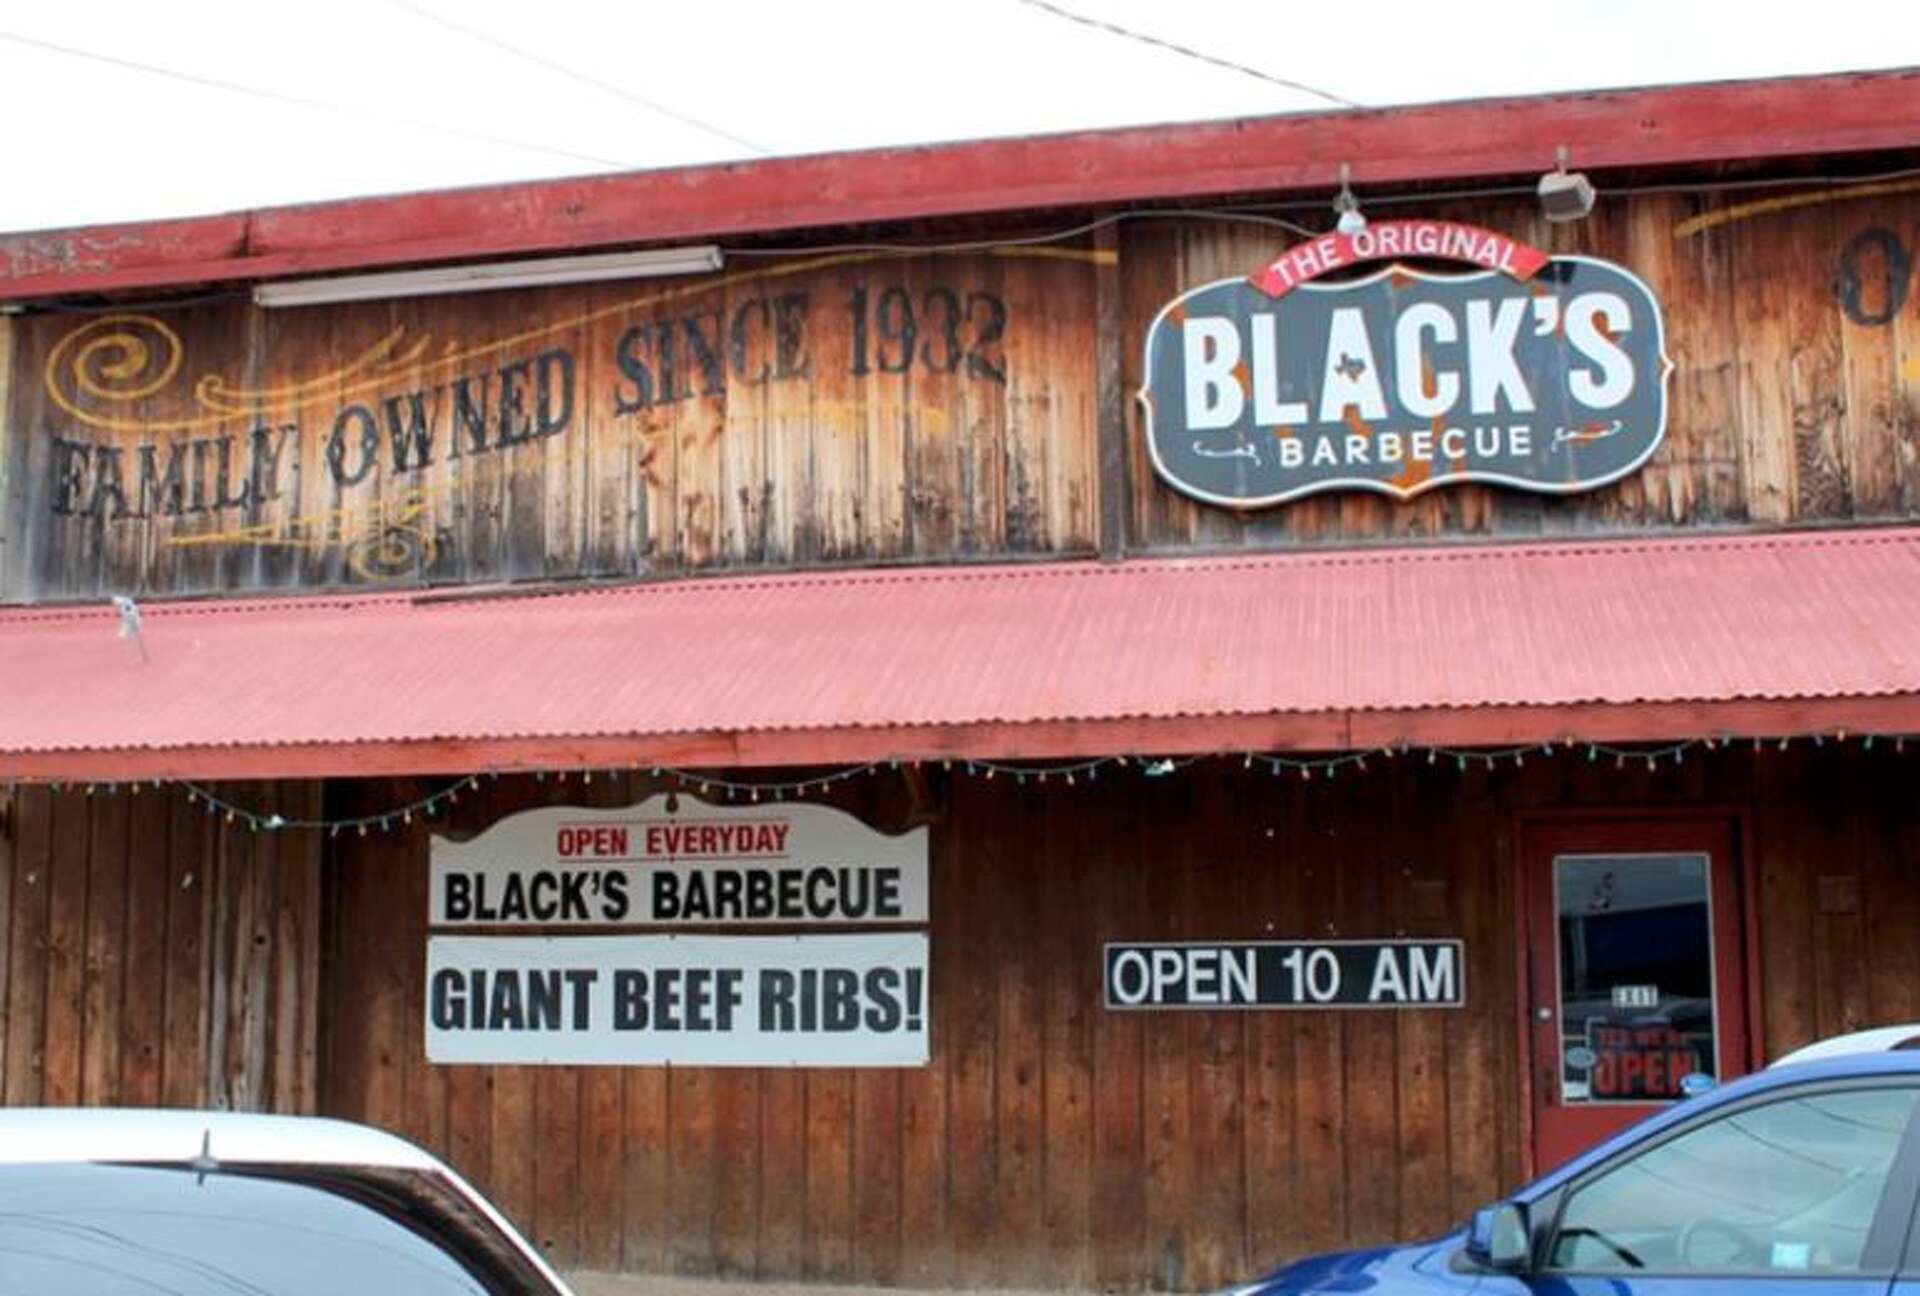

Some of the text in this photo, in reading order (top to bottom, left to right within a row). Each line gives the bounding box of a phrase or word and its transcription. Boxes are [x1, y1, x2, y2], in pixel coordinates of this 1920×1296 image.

[1271, 225, 1518, 287] THE ORIGINAL
[1182, 291, 1636, 431] BLACK'S
[50, 283, 1009, 520] FAMILY OWNED SINCE 1932
[1279, 425, 1534, 468] BARBECUE
[557, 824, 789, 856] OPEN EVERYDAY
[444, 867, 902, 922] BLACK'S BARBECUE
[430, 967, 924, 1033] GIANT BEEF RIBS!
[1111, 946, 1455, 1004] OPEN 10 AM
[1594, 1050, 1692, 1095] OPEN
